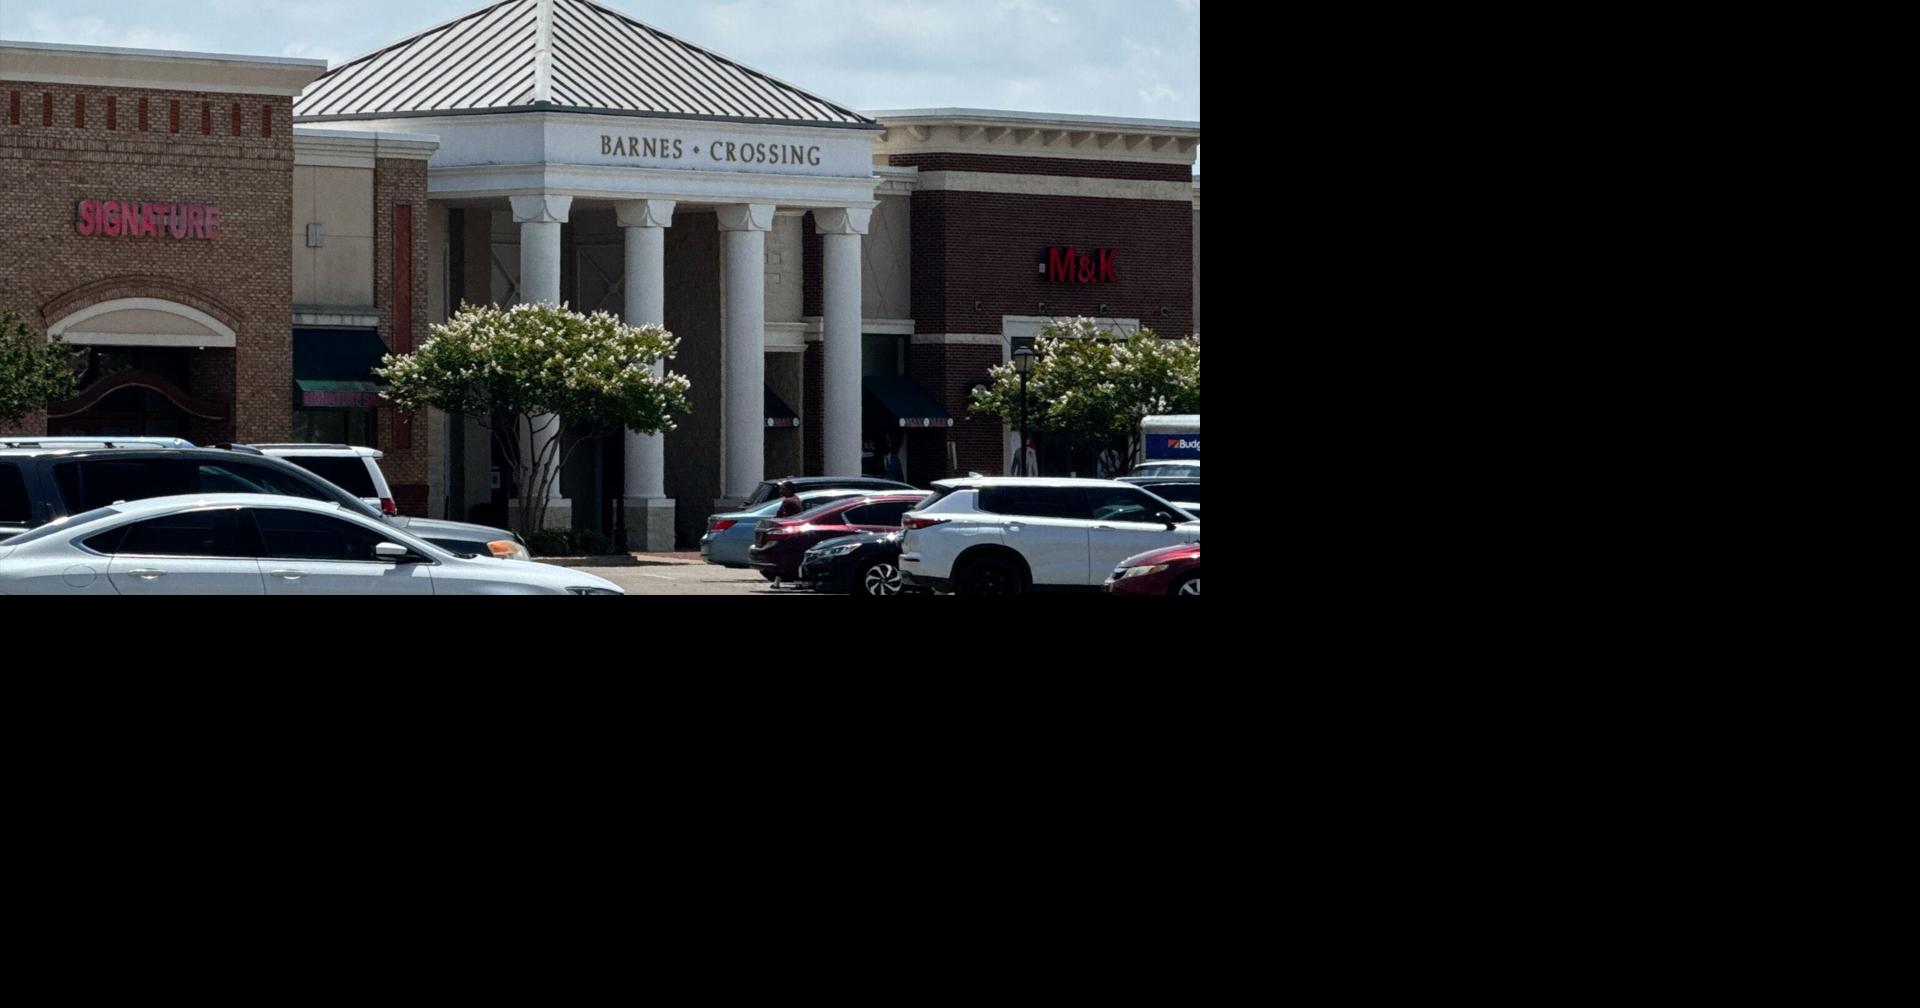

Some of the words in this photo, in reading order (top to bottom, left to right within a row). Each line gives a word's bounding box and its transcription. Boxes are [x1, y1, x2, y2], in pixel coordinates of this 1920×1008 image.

[601, 135, 682, 159] BARNES
[710, 141, 821, 166] CROSSING
[76, 198, 220, 240] SIGNATURE
[1047, 245, 1118, 283] M&K
